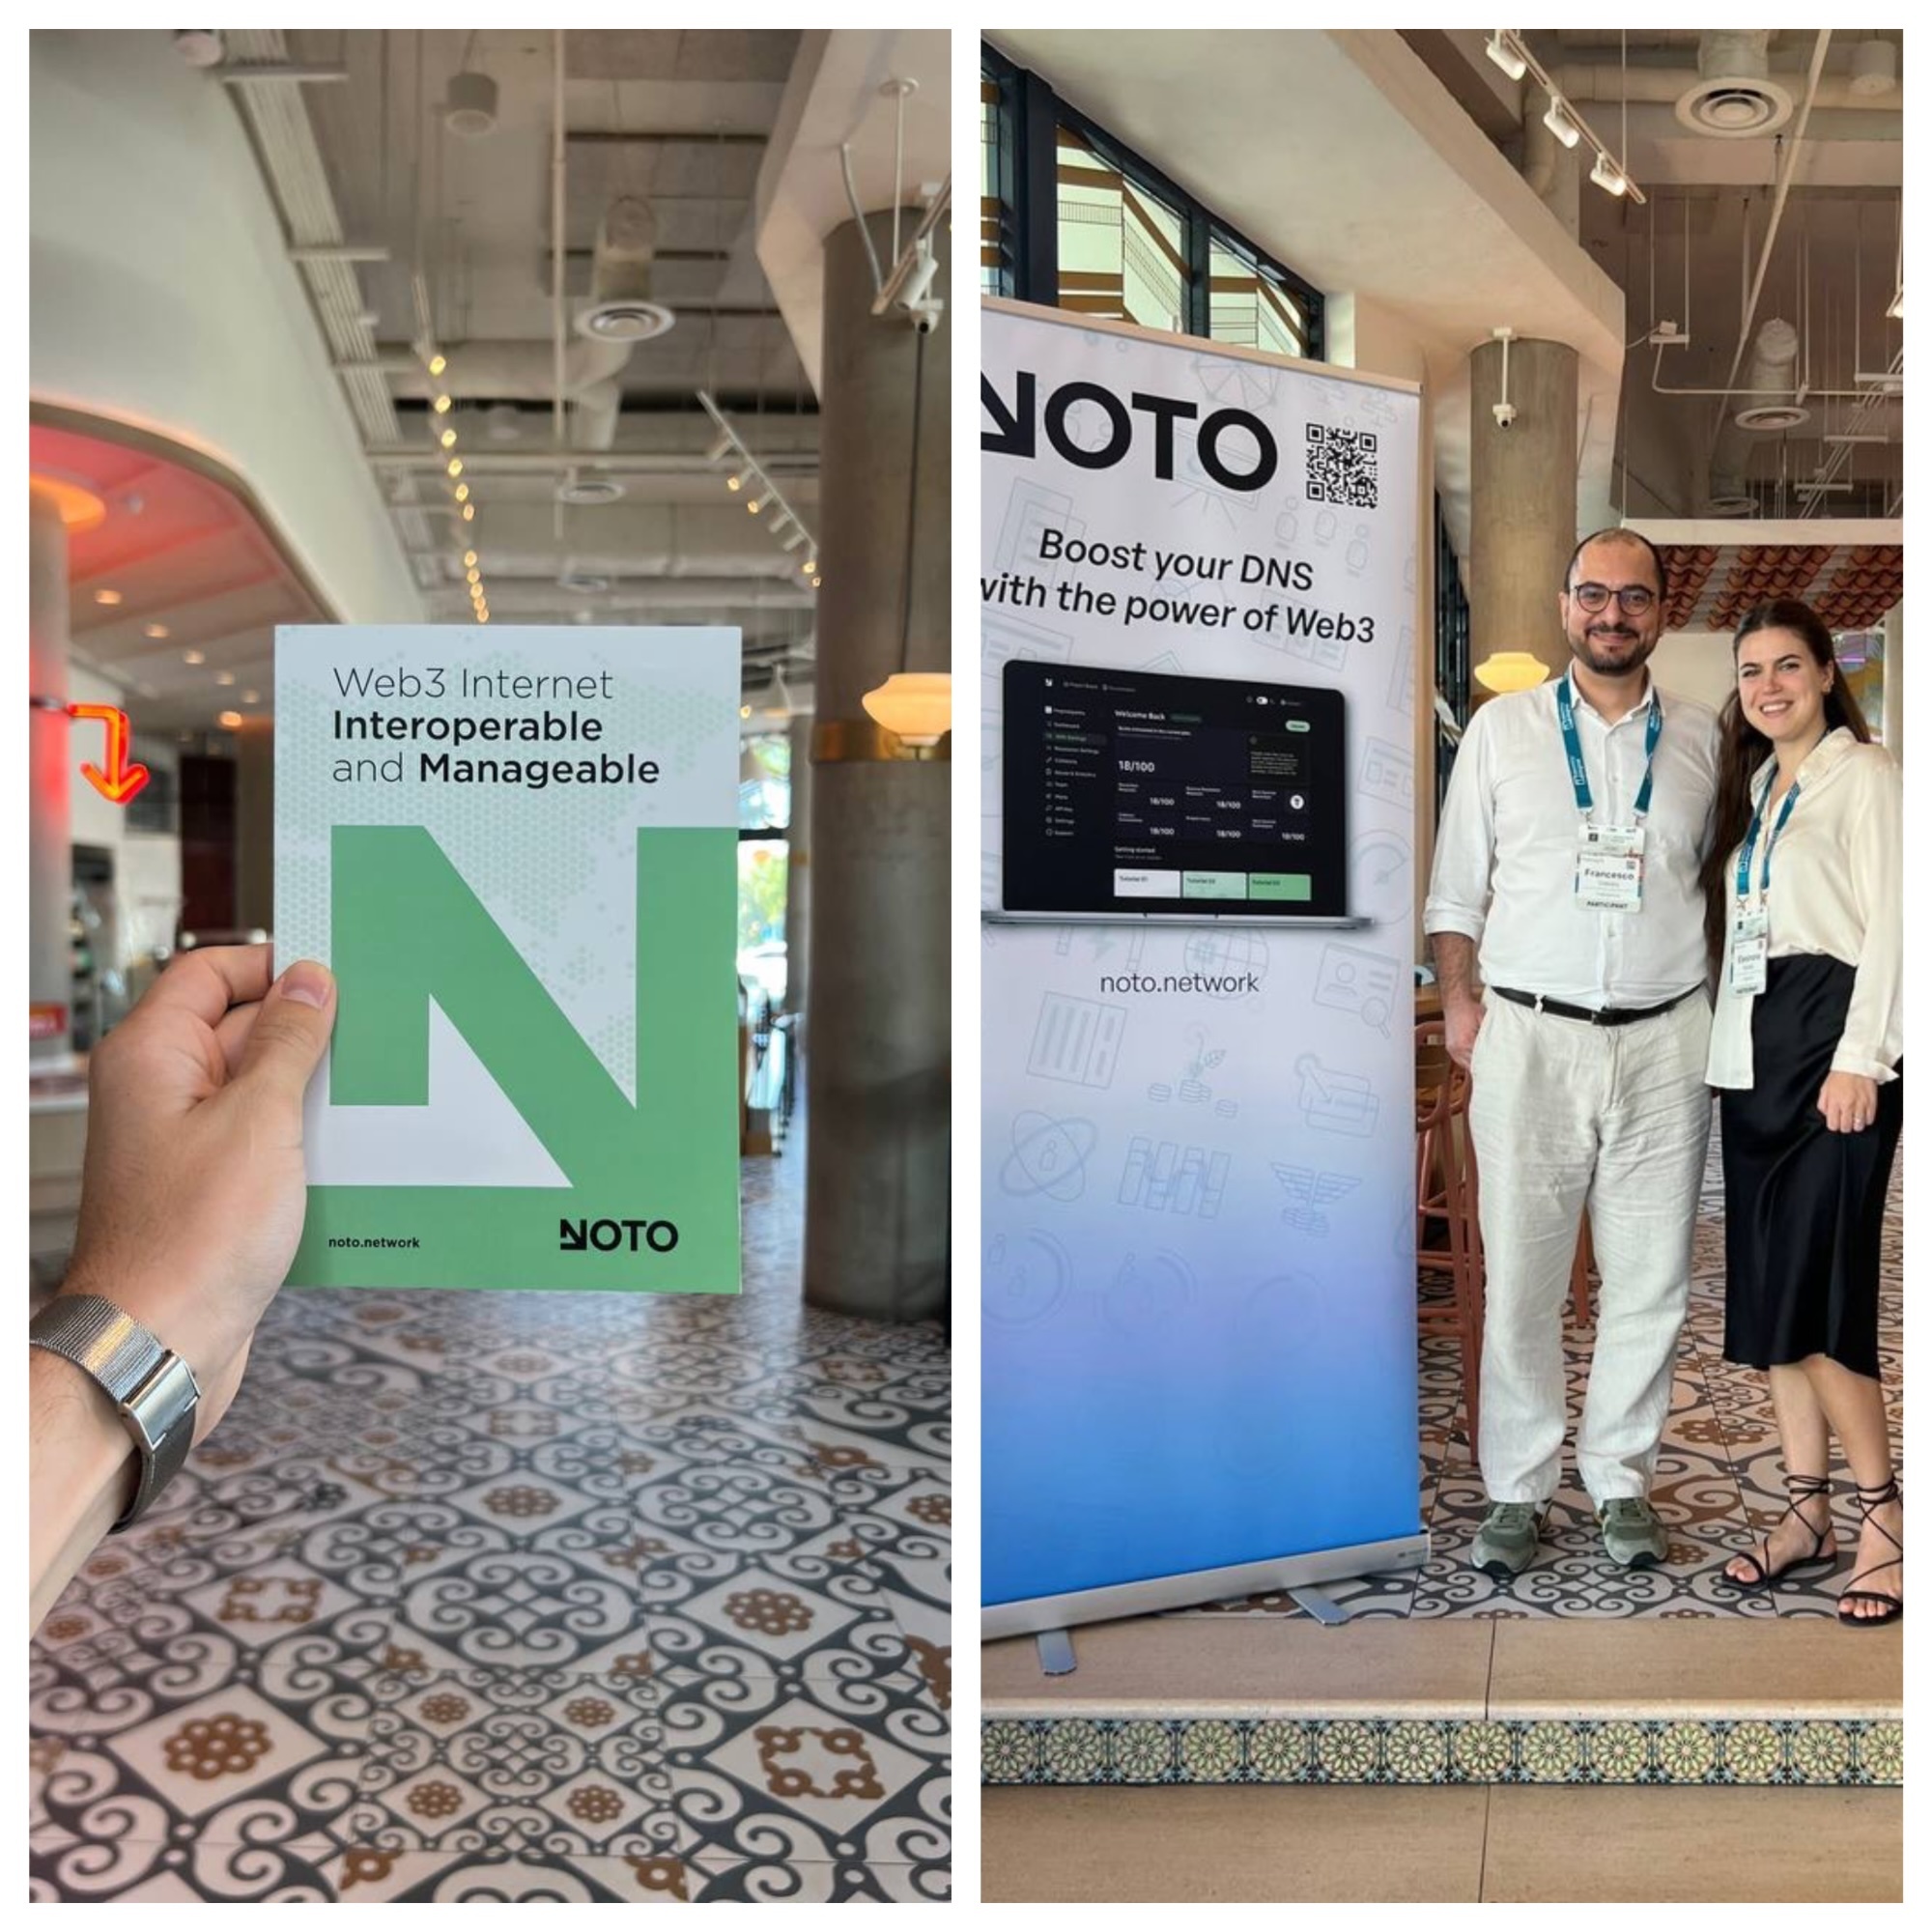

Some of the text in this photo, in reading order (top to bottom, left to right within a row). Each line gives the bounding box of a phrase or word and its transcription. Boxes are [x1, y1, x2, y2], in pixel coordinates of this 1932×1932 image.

[980, 371, 1278, 492] NOTO
[1039, 528, 1313, 590] Boost your DNS
[1057, 582, 1117, 615] the
[1123, 594, 1236, 627] power
[1243, 604, 1279, 632] of
[1284, 607, 1376, 642] Web3
[332, 667, 613, 699] Web3 Internet
[333, 710, 603, 746] Interoperable
[332, 753, 660, 789] and Manageable
[1118, 759, 1155, 774] 18/100
[1584, 868, 1634, 881] Francesco
[1099, 973, 1259, 994] noto.network
[328, 1236, 420, 1249] noto.network
[560, 1219, 679, 1252] NOTO
